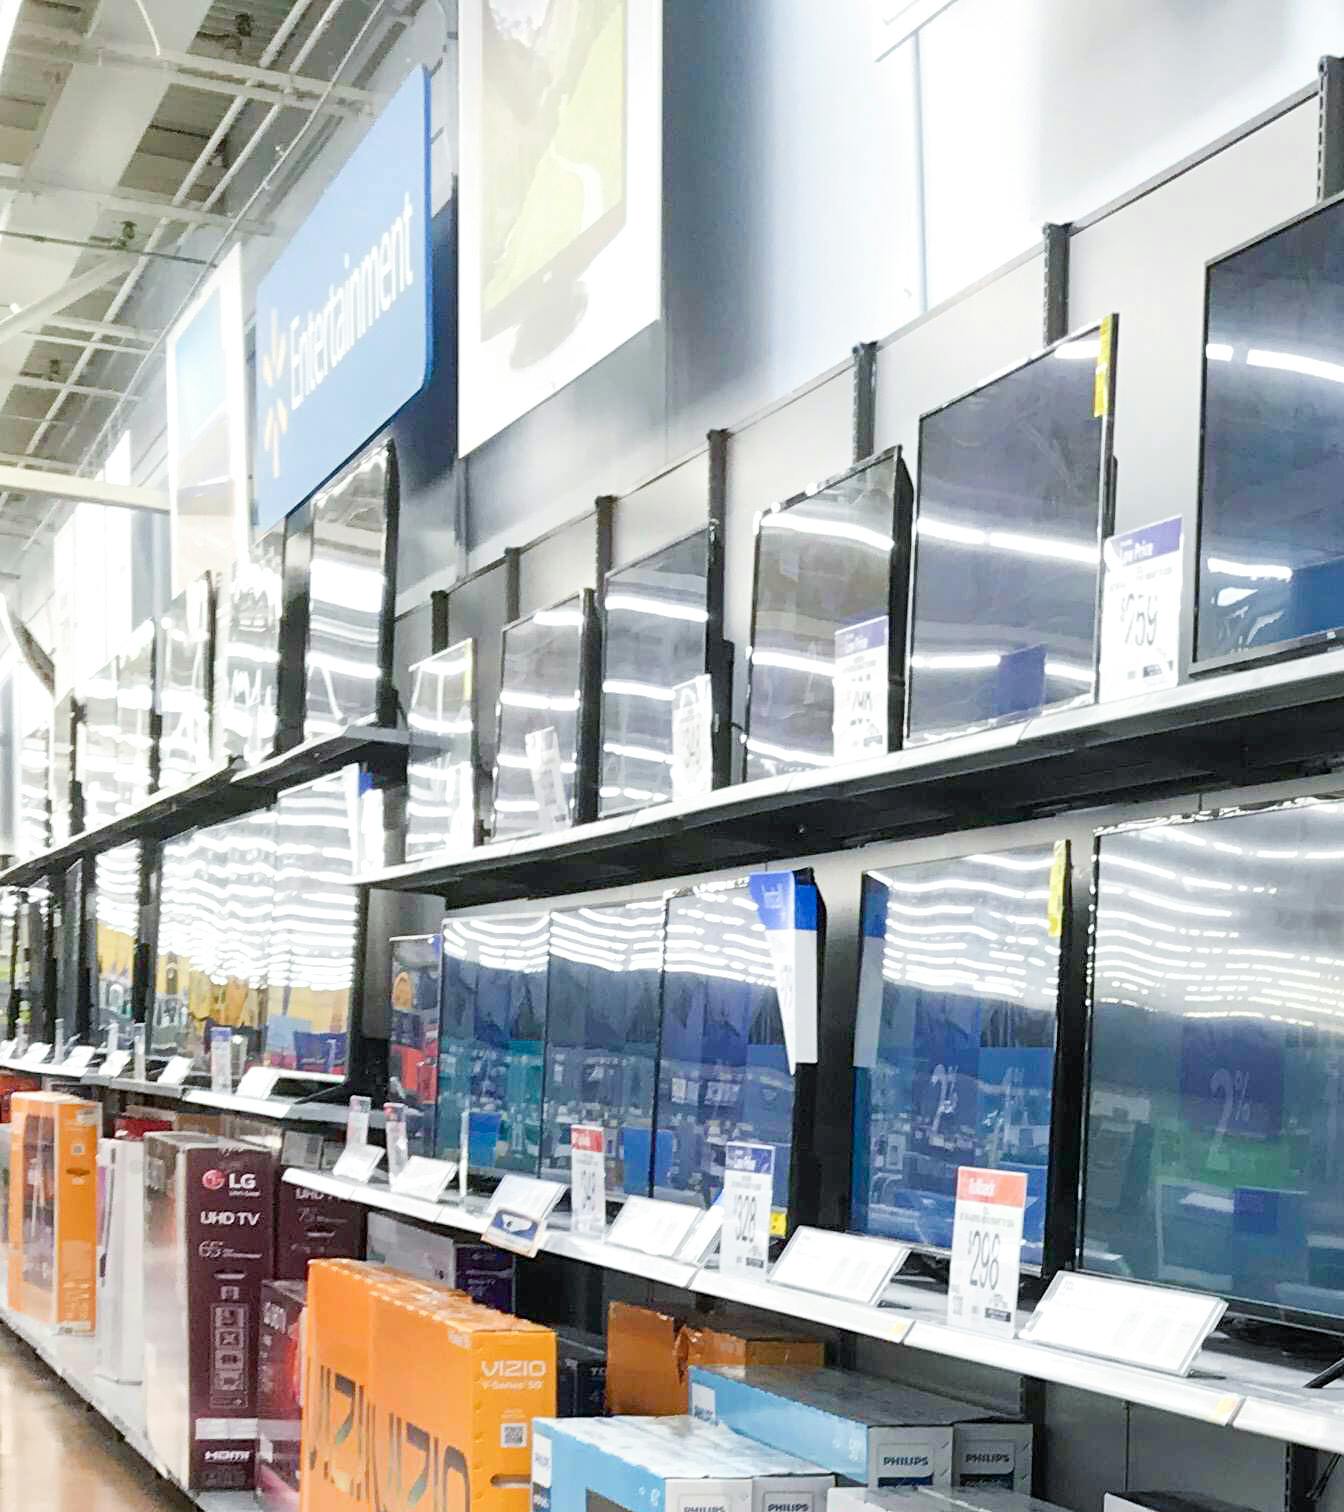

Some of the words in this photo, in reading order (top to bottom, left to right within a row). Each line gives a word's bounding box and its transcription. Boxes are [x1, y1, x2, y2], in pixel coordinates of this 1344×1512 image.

[290, 192, 414, 410] Entertainment
[229, 1173, 257, 1190] LG
[200, 1210, 232, 1226] UHD
[236, 1211, 260, 1226] TV
[481, 1360, 546, 1378] VIZIO
[883, 1455, 929, 1467] PHILIPS
[965, 1453, 1010, 1463] PHILIPS
[767, 1503, 809, 1512] PHILIPS
